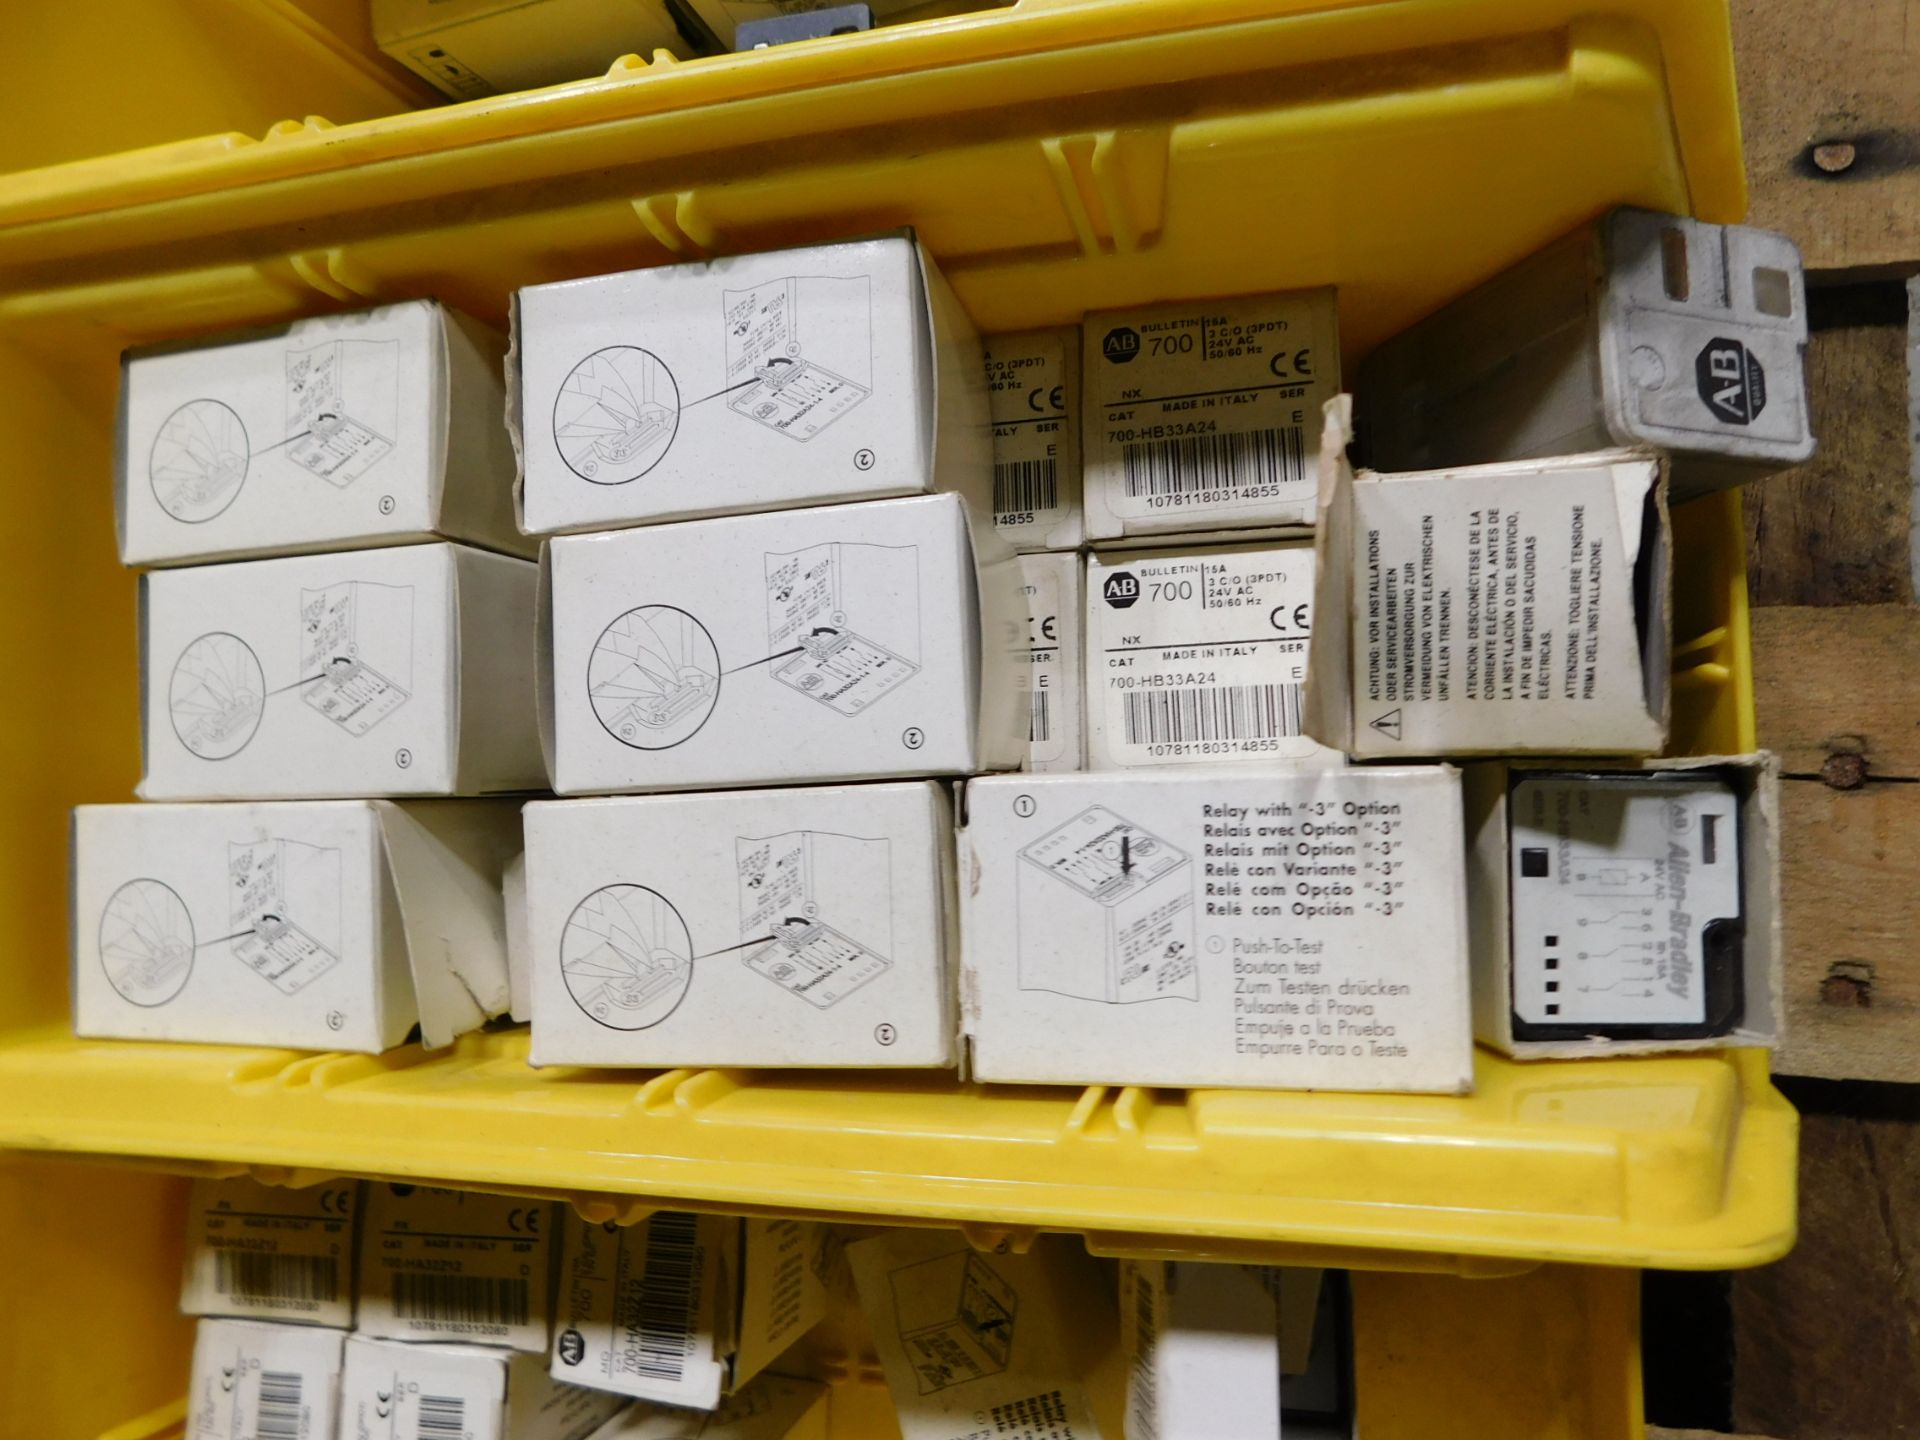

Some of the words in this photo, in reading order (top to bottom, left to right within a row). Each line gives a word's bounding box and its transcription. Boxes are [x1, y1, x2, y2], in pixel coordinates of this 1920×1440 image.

[1141, 319, 1199, 333] BULLETIN
[1221, 325, 1242, 337] C/O
[1246, 321, 1288, 334] (3PDT)
[1148, 334, 1193, 356] 700
[1209, 338, 1231, 348] 24V
[1237, 336, 1254, 346] AC
[1209, 347, 1242, 359] 50/60
[1247, 346, 1263, 355] Hz
[1007, 358, 1045, 369] (3PDT)
[1270, 349, 1311, 377] CE
[1001, 371, 1014, 380] AC
[1028, 386, 1064, 412] CE
[1122, 389, 1141, 398] NX
[1162, 401, 1198, 412] MADE
[1203, 398, 1215, 407] IN
[1220, 393, 1258, 406] ITALY
[1280, 389, 1305, 398] SER
[1109, 411, 1135, 421] CAT
[1293, 411, 1303, 422] E
[1037, 423, 1059, 432] SER
[1108, 421, 1216, 443] 700-HB33A24
[1047, 444, 1056, 455] E
[1147, 485, 1279, 508] 10781180314855
[1470, 511, 1481, 526] LA
[1488, 509, 1499, 523] DE
[1469, 530, 1480, 544] DE
[1506, 511, 1519, 569] SERVICIO,
[1571, 505, 1584, 563] TENSIONE
[1488, 528, 1499, 565] ANTES
[1422, 515, 1433, 601] ELEKTRISCHEN
[1141, 566, 1199, 577] BULLETIN
[1369, 530, 1380, 617] INSTALLATIONS
[1404, 563, 1415, 584] ZUR
[1524, 536, 1536, 602] SACUDIDAS
[1209, 578, 1216, 586] 3
[1221, 575, 1242, 585] C/O
[1246, 572, 1287, 584] (3PDT)
[1505, 574, 1517, 595] DEL
[1150, 581, 1192, 602] 700
[1209, 588, 1231, 597] 24V
[1238, 586, 1253, 595] AC
[1466, 549, 1480, 639] DESCONÉCTESE
[1569, 568, 1582, 624] TOGLIERE
[1209, 599, 1242, 608] 50/60
[1247, 598, 1261, 606] Hz
[1484, 569, 1500, 635] ELÉCTRICA,
[1270, 604, 1310, 631] CE
[1386, 568, 1397, 669] SERVICEARBEITEN
[1422, 605, 1432, 627] VON
[1440, 588, 1451, 641] TRENNEN.
[1369, 621, 1380, 643] VOR
[1522, 607, 1533, 651] IMPEDIR
[1123, 636, 1141, 644] NX
[1280, 643, 1304, 653] SER
[1404, 589, 1415, 701] STROMVERSORGUNG
[1501, 606, 1516, 683] INSTALACIÓN
[1163, 650, 1198, 660] MADE
[1202, 649, 1215, 658] IN
[1220, 646, 1258, 656] ITALY
[1109, 658, 1135, 667] CAT
[1421, 632, 1432, 701] VERMEIDUNG
[1485, 640, 1497, 700] CORRIENTE
[1522, 656, 1532, 669] DE
[1565, 629, 1579, 699] ATTENZIONE:
[1040, 675, 1048, 687] E
[1109, 672, 1216, 688] 700-HB33A24
[1293, 667, 1302, 678] E
[1369, 647, 1381, 701] ACHTUNG:
[1521, 673, 1532, 689] FIN
[1386, 673, 1397, 701] ODER
[1583, 667, 1595, 699] PRIMA
[1503, 687, 1513, 699] LA
[1147, 739, 1279, 757] 10781180314855
[1203, 804, 1249, 821] Relay
[1255, 802, 1292, 817] with
[1343, 801, 1401, 819] Option
[1204, 825, 1251, 837] Relais
[1258, 824, 1295, 836] avec
[1300, 822, 1358, 840] Option
[1204, 844, 1253, 857] Relais
[1262, 842, 1288, 856] mit
[1296, 842, 1355, 859] Option
[1247, 865, 1276, 876] con
[1283, 863, 1356, 876] Variante
[1654, 858, 1665, 881] 24V
[1251, 885, 1286, 896] com
[1296, 882, 1353, 900] Opção
[1655, 883, 1665, 900] AC
[1252, 904, 1281, 916] con
[1292, 902, 1354, 919] Opción
[1667, 841, 1693, 1000] Allen-Bradley
[1233, 937, 1323, 954] Push-To-Test
[1233, 958, 1288, 975] Bouton
[1294, 958, 1321, 974] test
[1234, 978, 1271, 994] Zum
[1277, 979, 1330, 995] Testen
[1338, 979, 1411, 996] drücken
[1234, 998, 1300, 1015] Pulsante
[1305, 999, 1321, 1015] di
[1327, 999, 1374, 1016] Prova
[1235, 1017, 1294, 1039] Empuje
[1300, 1022, 1310, 1035] a
[1316, 1019, 1331, 1036] la
[1337, 1020, 1395, 1037] Prueba
[1235, 1037, 1301, 1058] Empurre
[1308, 1039, 1345, 1056] Para
[1369, 1040, 1408, 1057] Teste
[580, 1289, 592, 1322] 700
[623, 1280, 644, 1374] 700-HA32Z12
